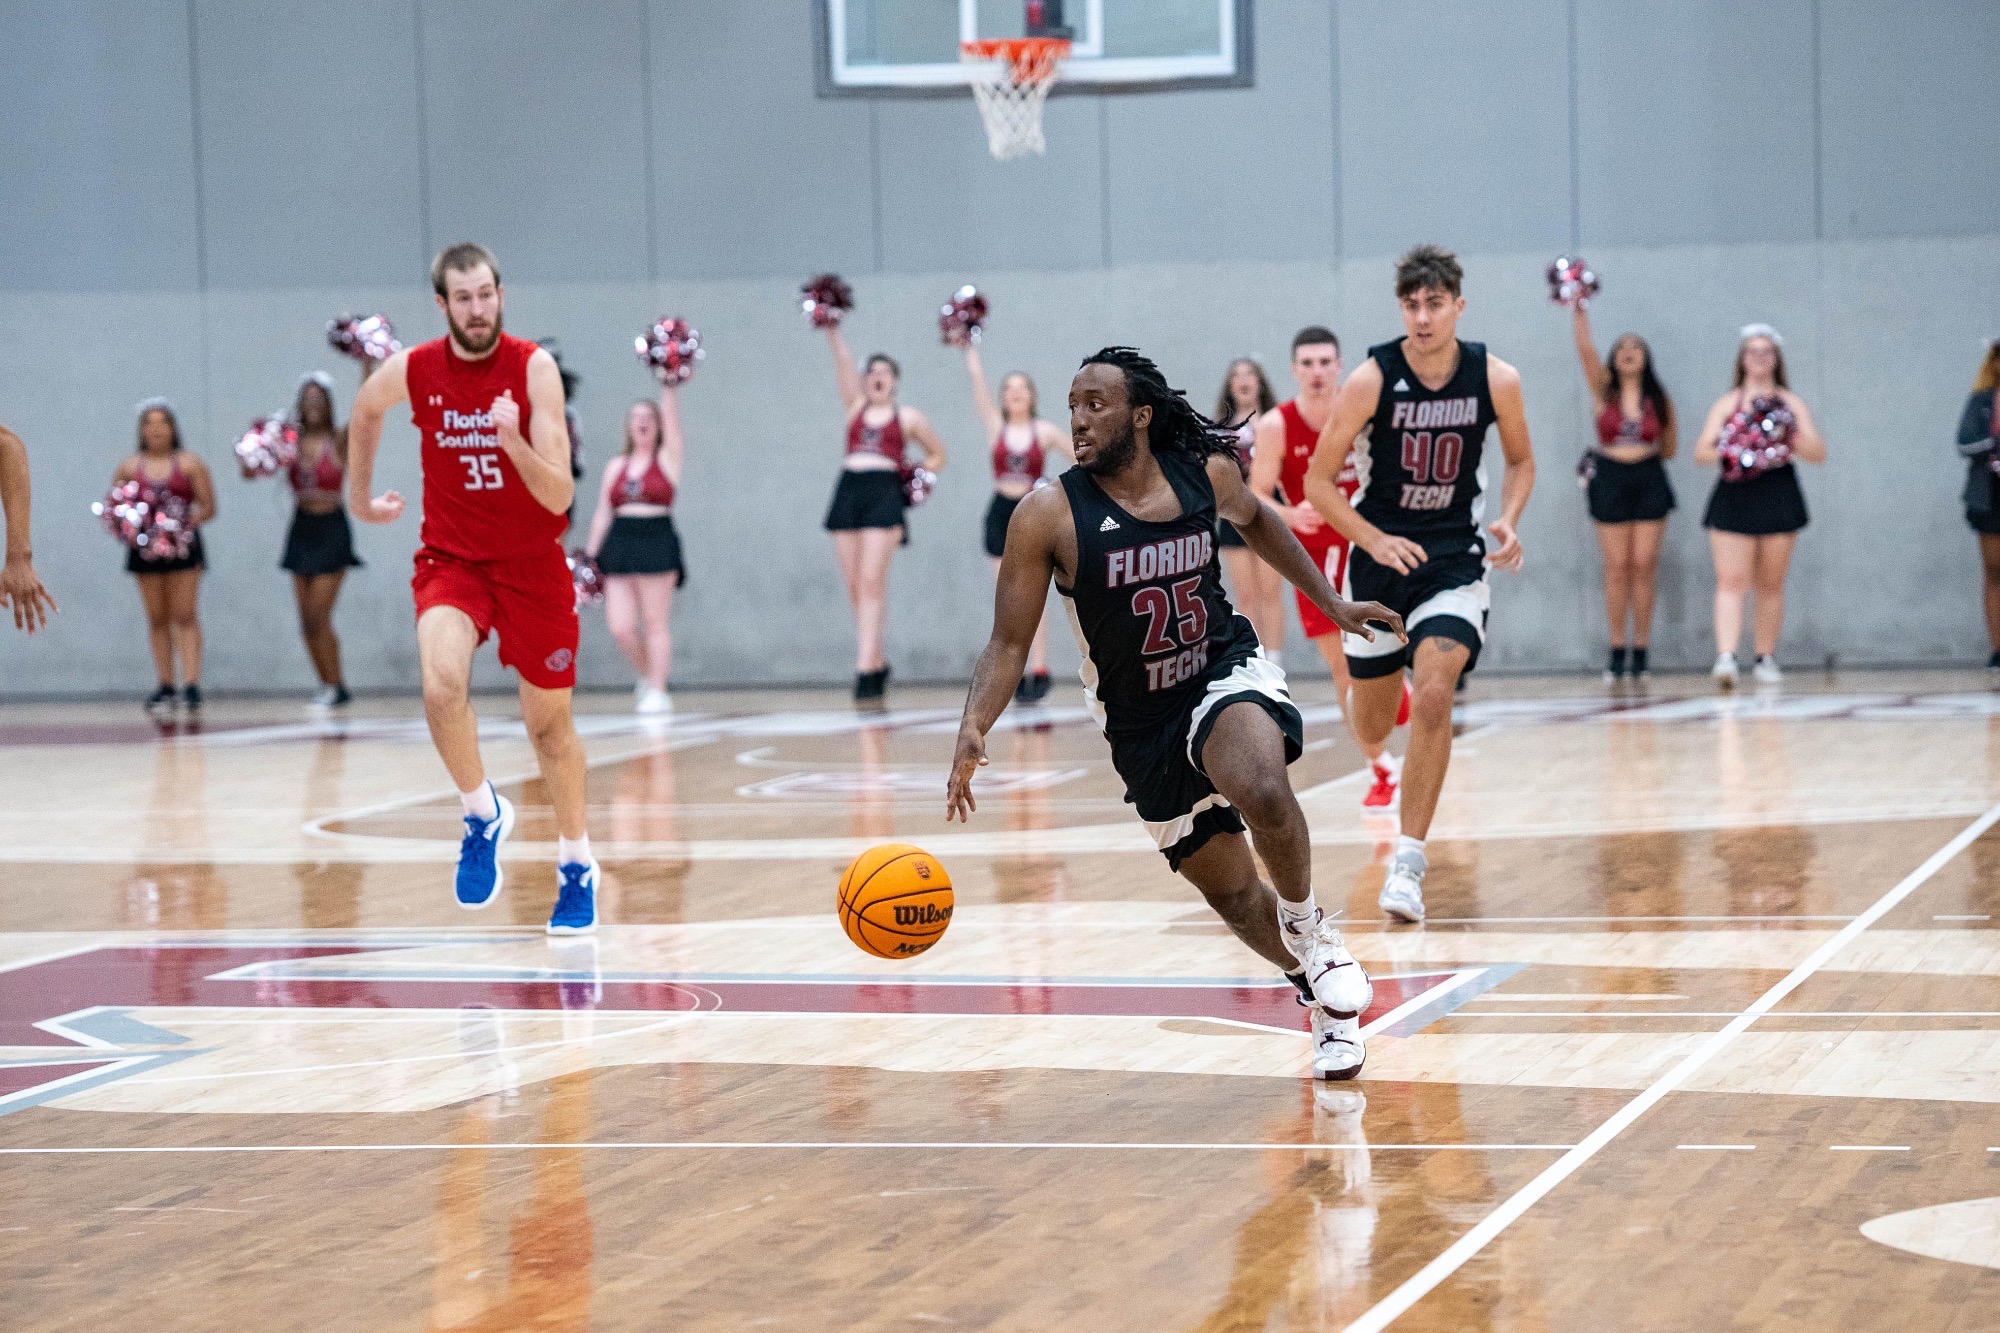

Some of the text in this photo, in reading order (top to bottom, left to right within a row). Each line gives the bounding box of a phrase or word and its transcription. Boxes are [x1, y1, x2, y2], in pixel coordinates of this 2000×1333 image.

[443, 408, 495, 430] Florid
[1391, 397, 1478, 430] FLORIDA
[435, 430, 499, 449] Southe
[459, 453, 504, 490] 35
[1401, 431, 1463, 484] 40
[1399, 483, 1456, 511] TECH
[1100, 523, 1120, 532] adidas
[1106, 530, 1213, 589] FLORIDA
[1131, 574, 1208, 655] 25
[1143, 639, 1209, 693] TECH
